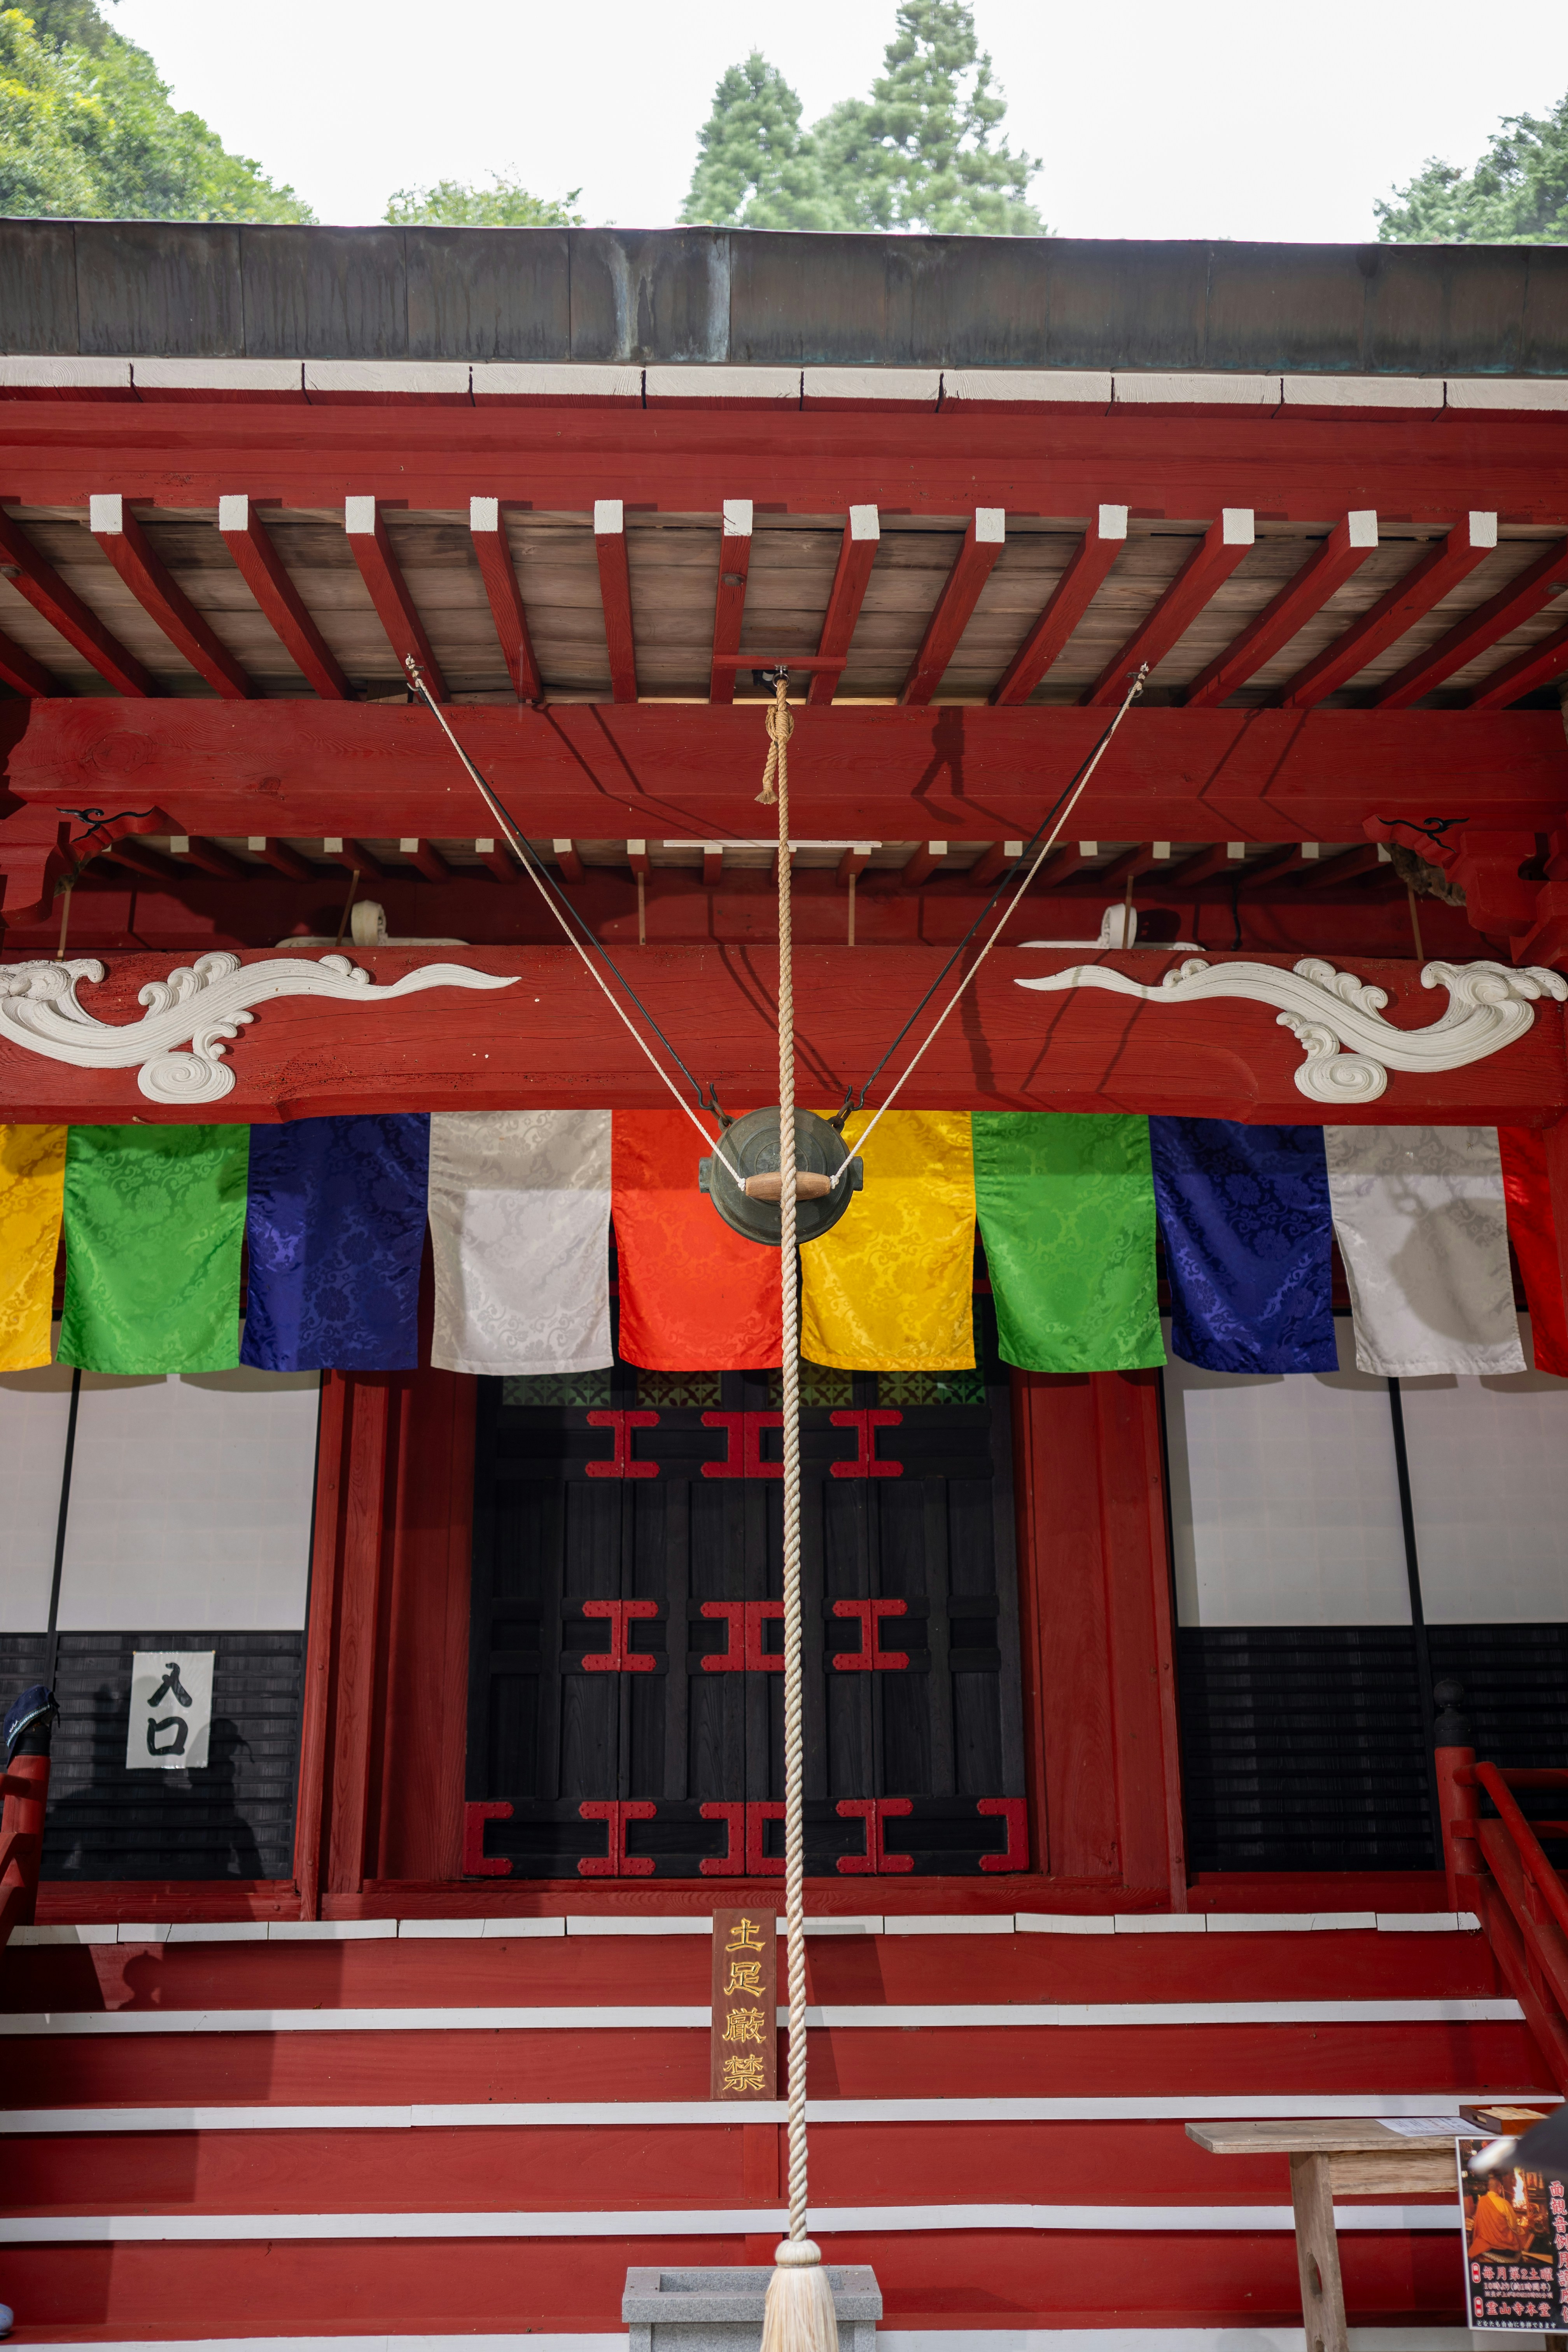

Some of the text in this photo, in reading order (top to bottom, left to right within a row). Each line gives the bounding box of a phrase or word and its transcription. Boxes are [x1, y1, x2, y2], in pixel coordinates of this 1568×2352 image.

[147, 1662, 192, 1756] 入口
[723, 1918, 766, 2091] 土足厳禁
[1482, 2266, 1554, 2281] 毎月第2土曜
[1486, 2301, 1551, 2317] 霊山寺本堂
[1477, 2320, 1556, 2329] どなたも自由に参拝できます
